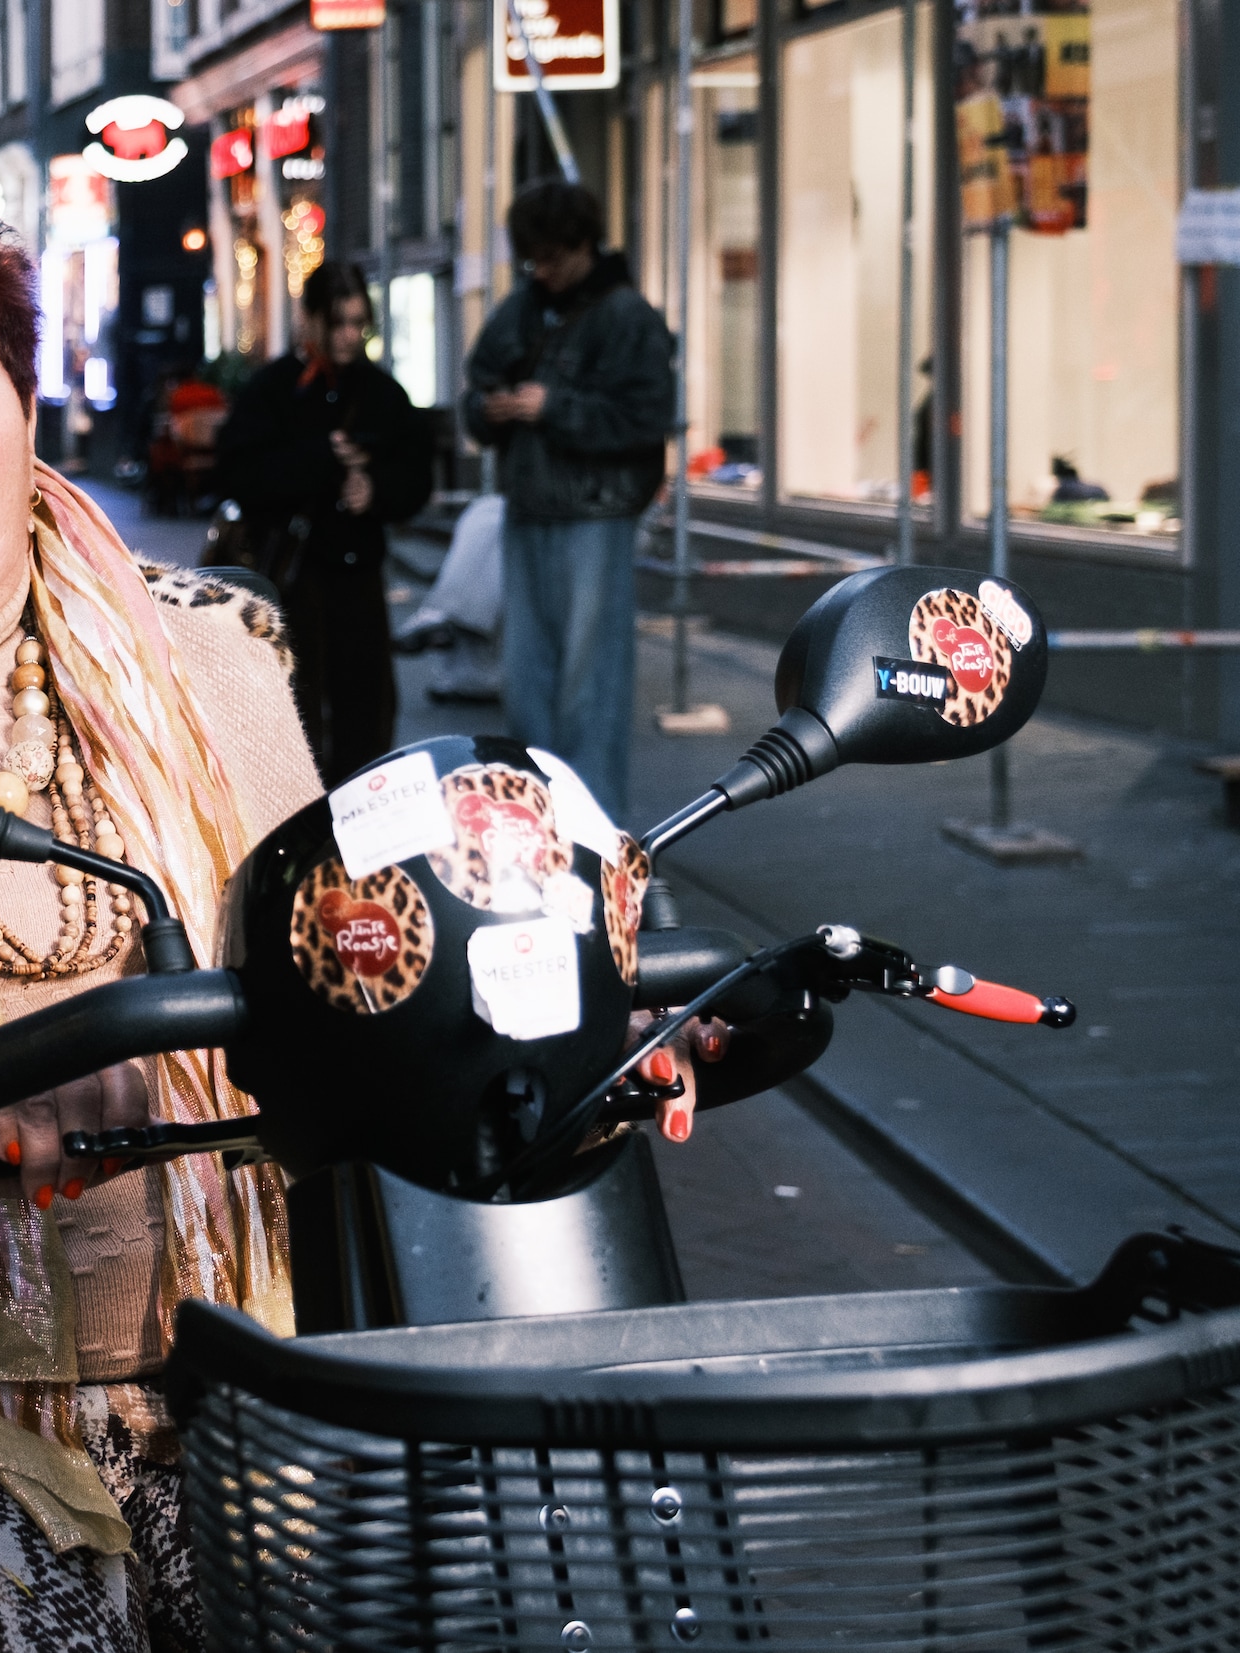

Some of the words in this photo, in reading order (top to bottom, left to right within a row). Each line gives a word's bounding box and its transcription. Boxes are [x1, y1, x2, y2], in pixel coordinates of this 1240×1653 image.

[877, 668, 946, 700] Y-BOUW
[340, 781, 428, 826] MEESTER
[347, 919, 387, 936] Tante
[481, 955, 568, 982] MEESTER
